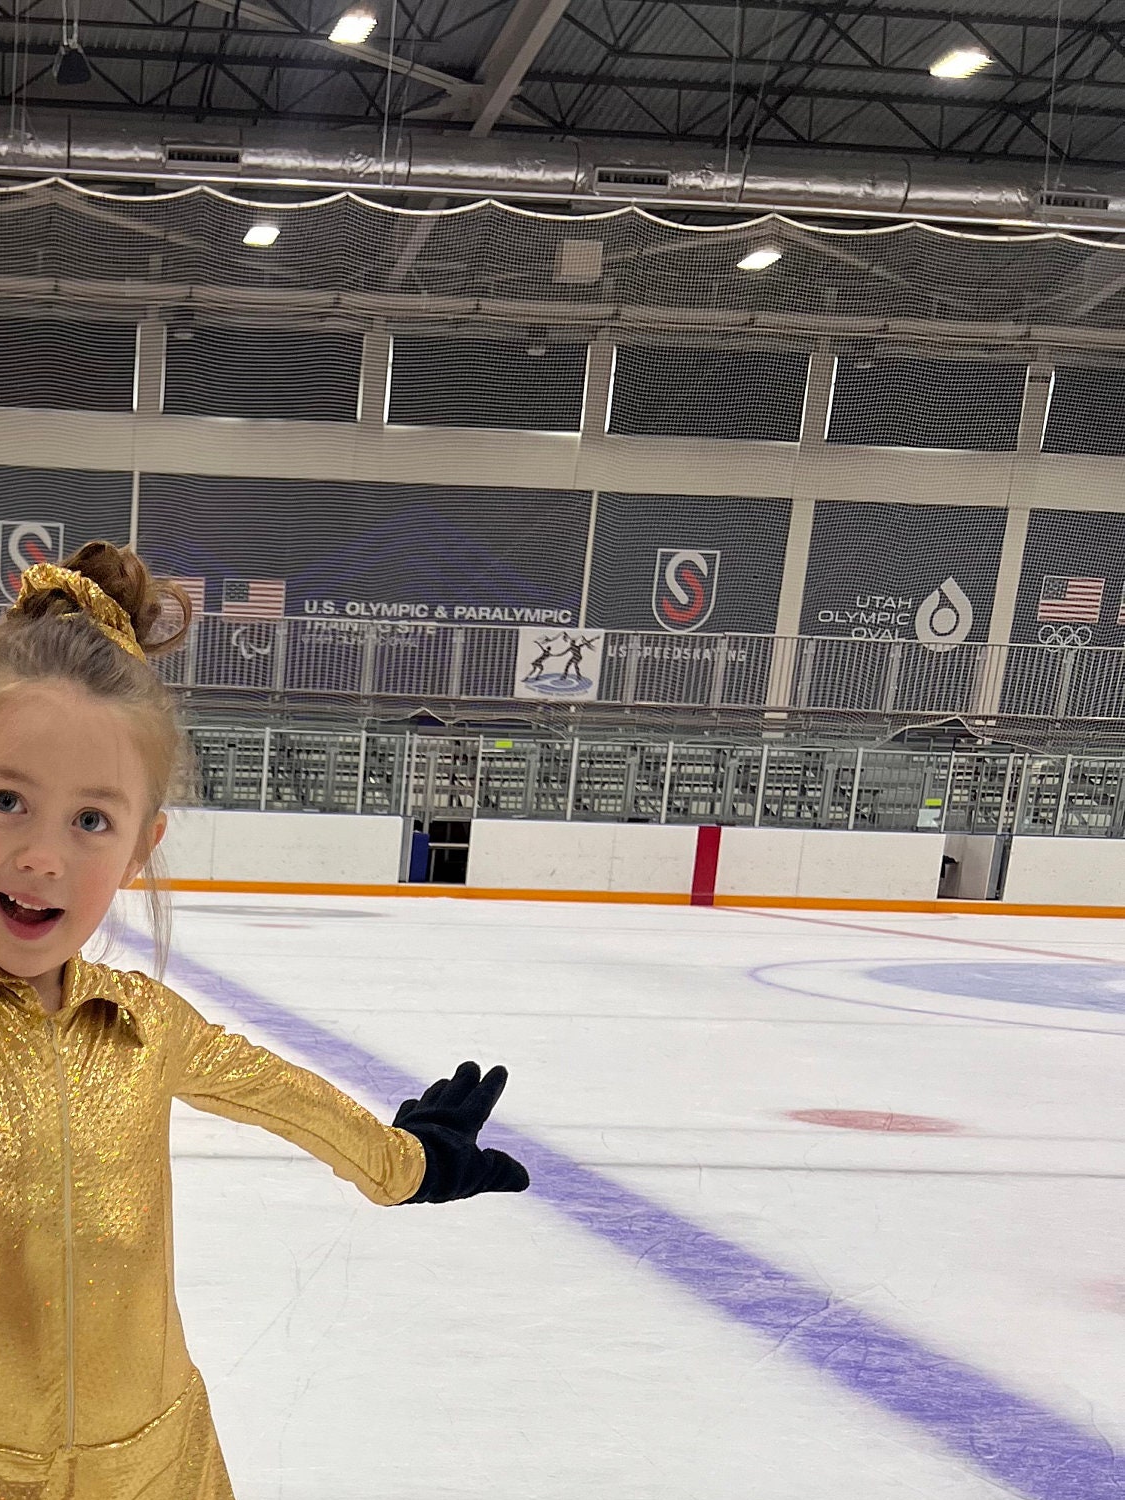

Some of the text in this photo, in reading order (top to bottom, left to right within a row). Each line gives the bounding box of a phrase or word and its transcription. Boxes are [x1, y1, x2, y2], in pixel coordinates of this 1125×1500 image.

[856, 595, 912, 609] UTAH
[304, 599, 572, 624] U.S. OLYMPIC & PARALYMPIC
[818, 610, 910, 625] OLYMPIC
[852, 627, 906, 641] OVAL
